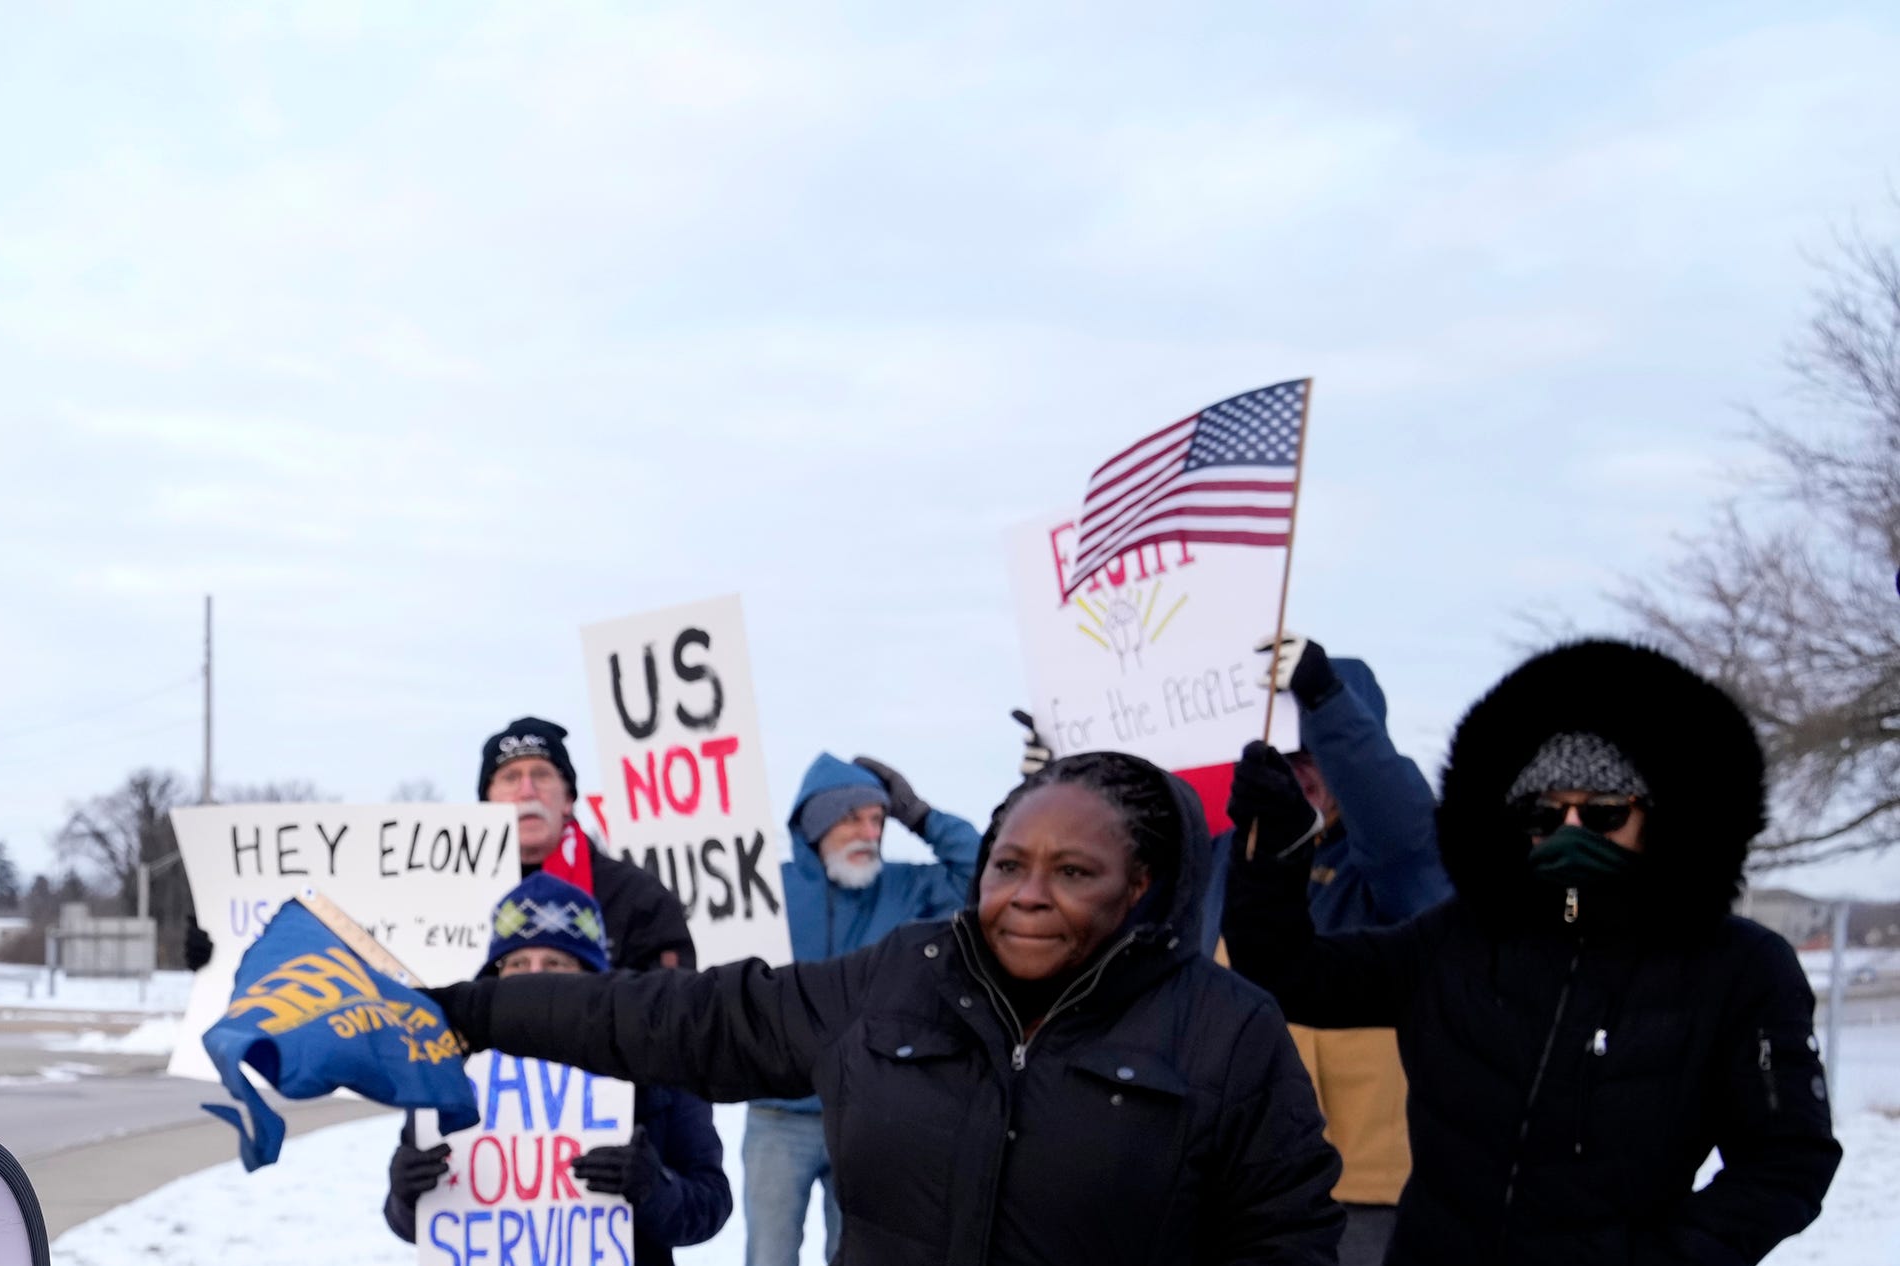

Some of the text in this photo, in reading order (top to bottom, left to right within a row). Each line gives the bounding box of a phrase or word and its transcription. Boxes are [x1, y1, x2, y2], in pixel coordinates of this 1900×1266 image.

[609, 627, 724, 739] US
[1106, 688, 1157, 742] the
[1162, 663, 1254, 729] PEOPLE
[621, 736, 740, 822] NOT
[232, 820, 511, 878] HEY ELON!
[473, 1049, 619, 1131] AVE
[469, 1135, 583, 1206] OUR
